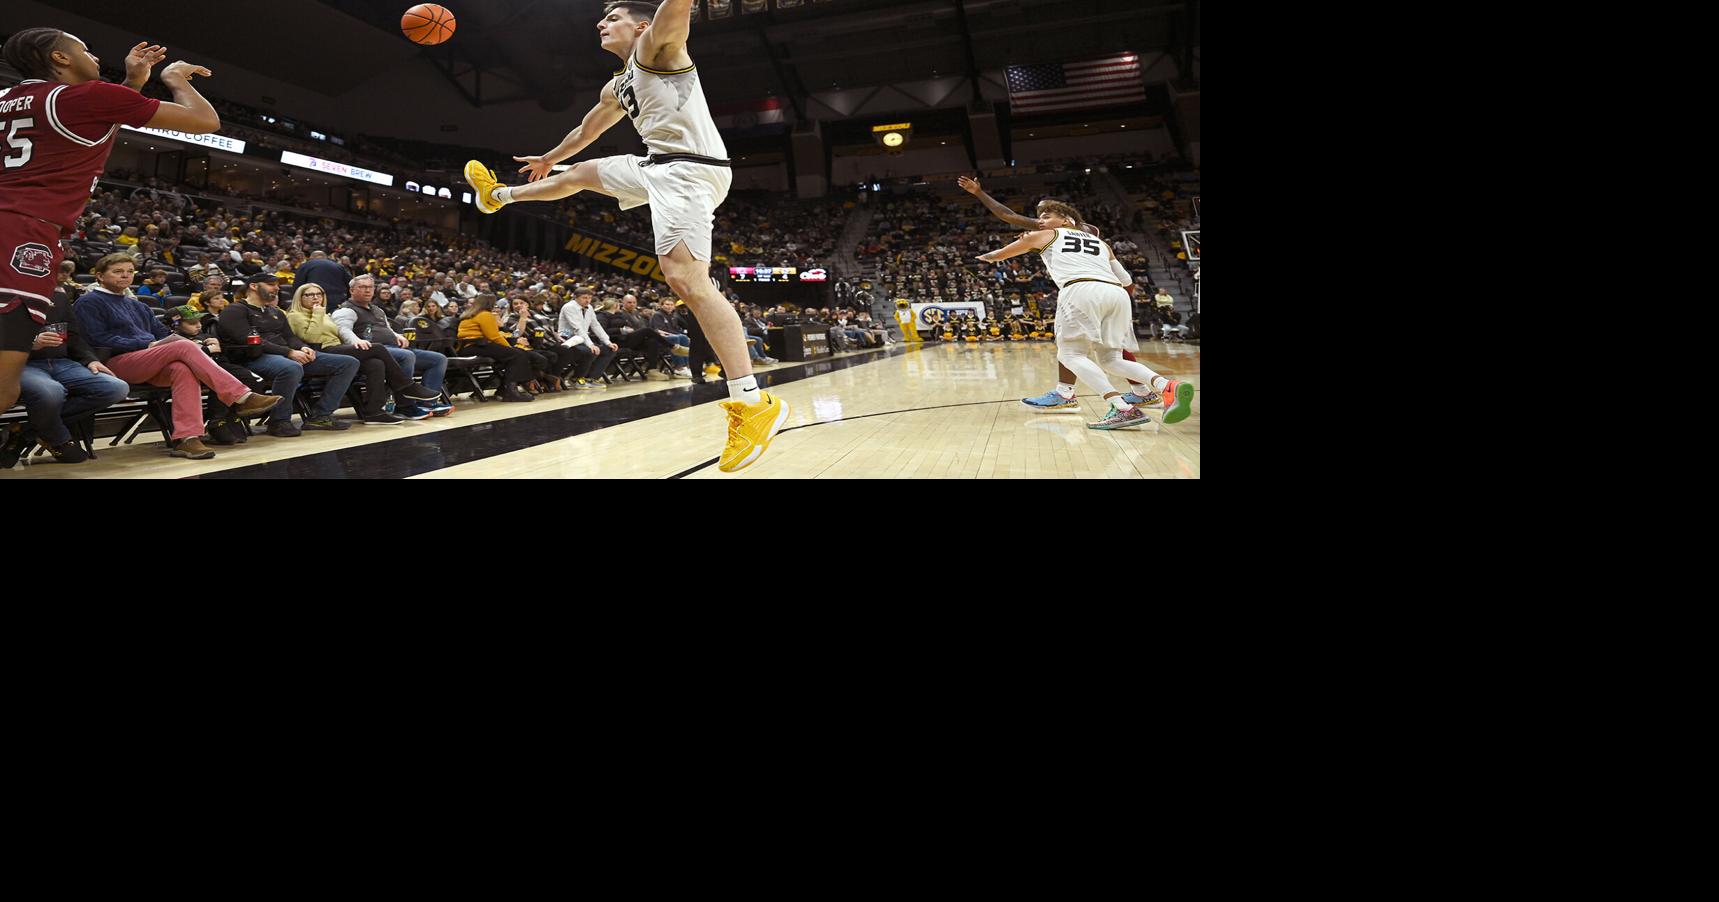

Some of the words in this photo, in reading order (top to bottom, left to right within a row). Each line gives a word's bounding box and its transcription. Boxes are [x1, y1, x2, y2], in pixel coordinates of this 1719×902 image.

[0, 117, 34, 168] 5
[185, 132, 233, 149] COFFEE
[1061, 236, 1100, 256] 35
